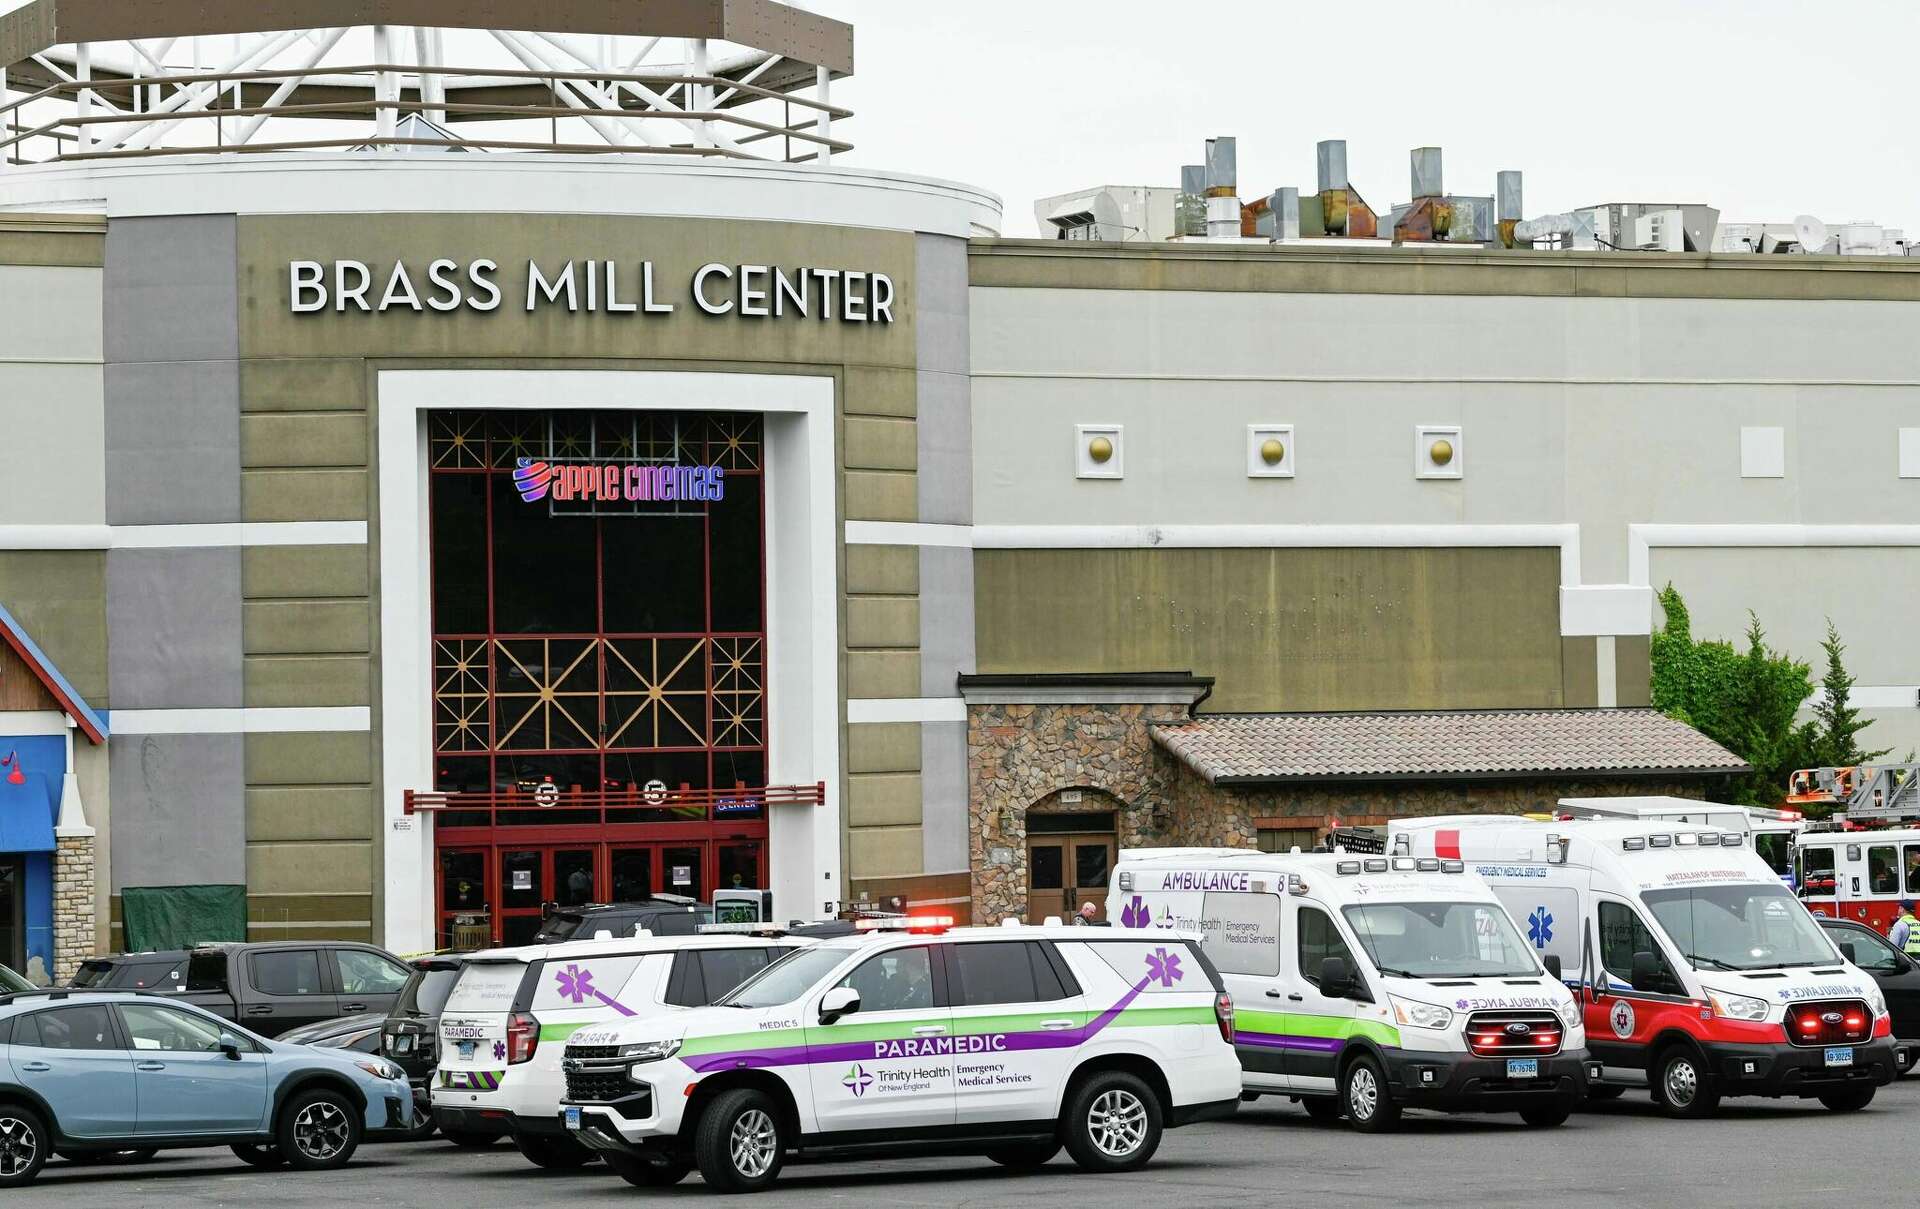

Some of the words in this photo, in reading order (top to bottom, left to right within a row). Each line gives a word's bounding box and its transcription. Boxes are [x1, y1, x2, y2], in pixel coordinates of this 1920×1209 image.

[289, 259, 502, 313] BRASS
[526, 259, 674, 313] MILL
[691, 263, 894, 324] CENTER
[552, 464, 619, 501] apple
[624, 464, 724, 501] cinemas
[1162, 872, 1249, 891] AMBULANCE
[1278, 874, 1285, 892] 8
[1175, 916, 1197, 932] Trinity
[1226, 920, 1260, 933] Emergency
[1225, 933, 1249, 944] Medical
[1249, 934, 1275, 944] Services
[444, 1027, 484, 1038] PARAMEDIC
[759, 1020, 791, 1030] MEDIC
[874, 1034, 1007, 1058] PARAMEDIC
[877, 1069, 912, 1082] Trinity
[913, 1066, 950, 1079] Health
[956, 1063, 1005, 1075] Emergency
[878, 1085, 886, 1093] Of
[887, 1083, 902, 1092] New
[903, 1082, 930, 1092] England
[958, 1075, 994, 1087] Medical
[996, 1073, 1032, 1085] Services
